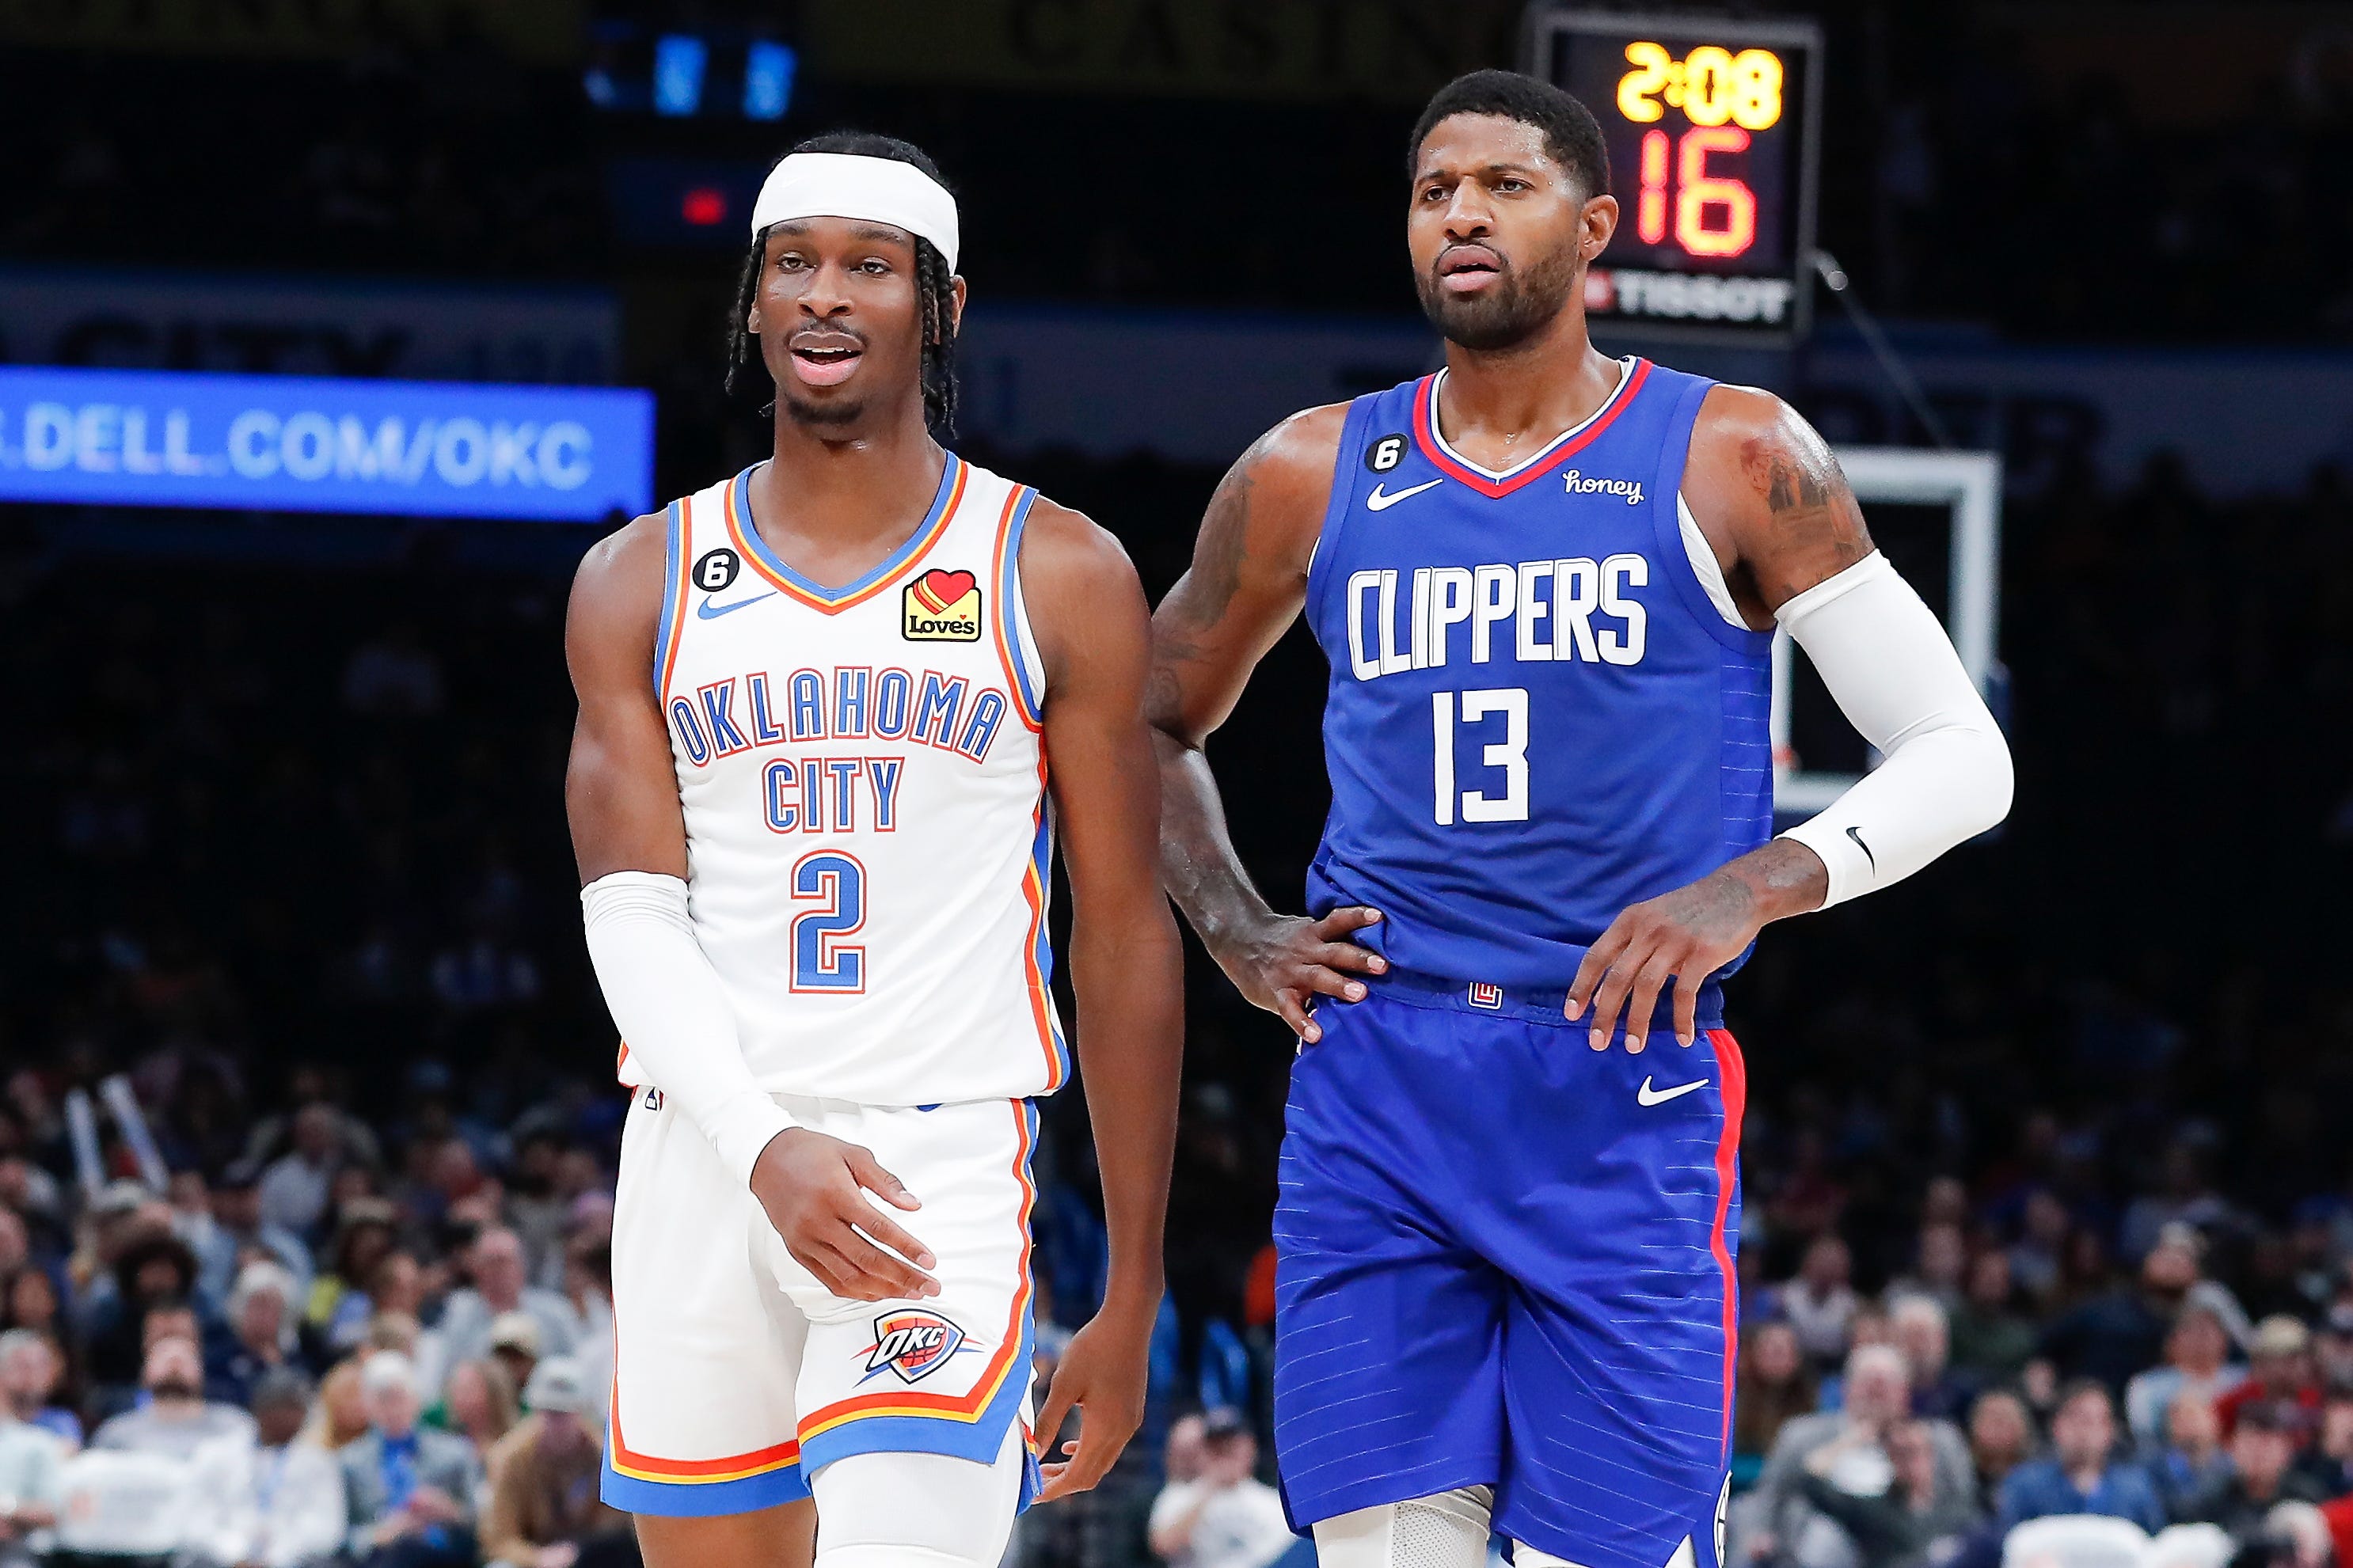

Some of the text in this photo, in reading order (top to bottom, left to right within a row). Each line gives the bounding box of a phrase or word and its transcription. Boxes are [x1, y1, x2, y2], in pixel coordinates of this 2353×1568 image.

[1617, 41, 1783, 131] 2:08
[1638, 126, 1757, 256] 16
[1611, 268, 1793, 325] TISSOT
[1374, 438, 1401, 470] 6
[1562, 469, 1645, 505] honey
[702, 553, 731, 587] 6
[1348, 553, 1648, 681] CLIPPERS
[670, 666, 1007, 767] OKLAHOMA
[1431, 688, 1529, 826] 13
[762, 757, 905, 833] CITY
[789, 849, 867, 994] 2
[866, 1327, 946, 1370] OKC
